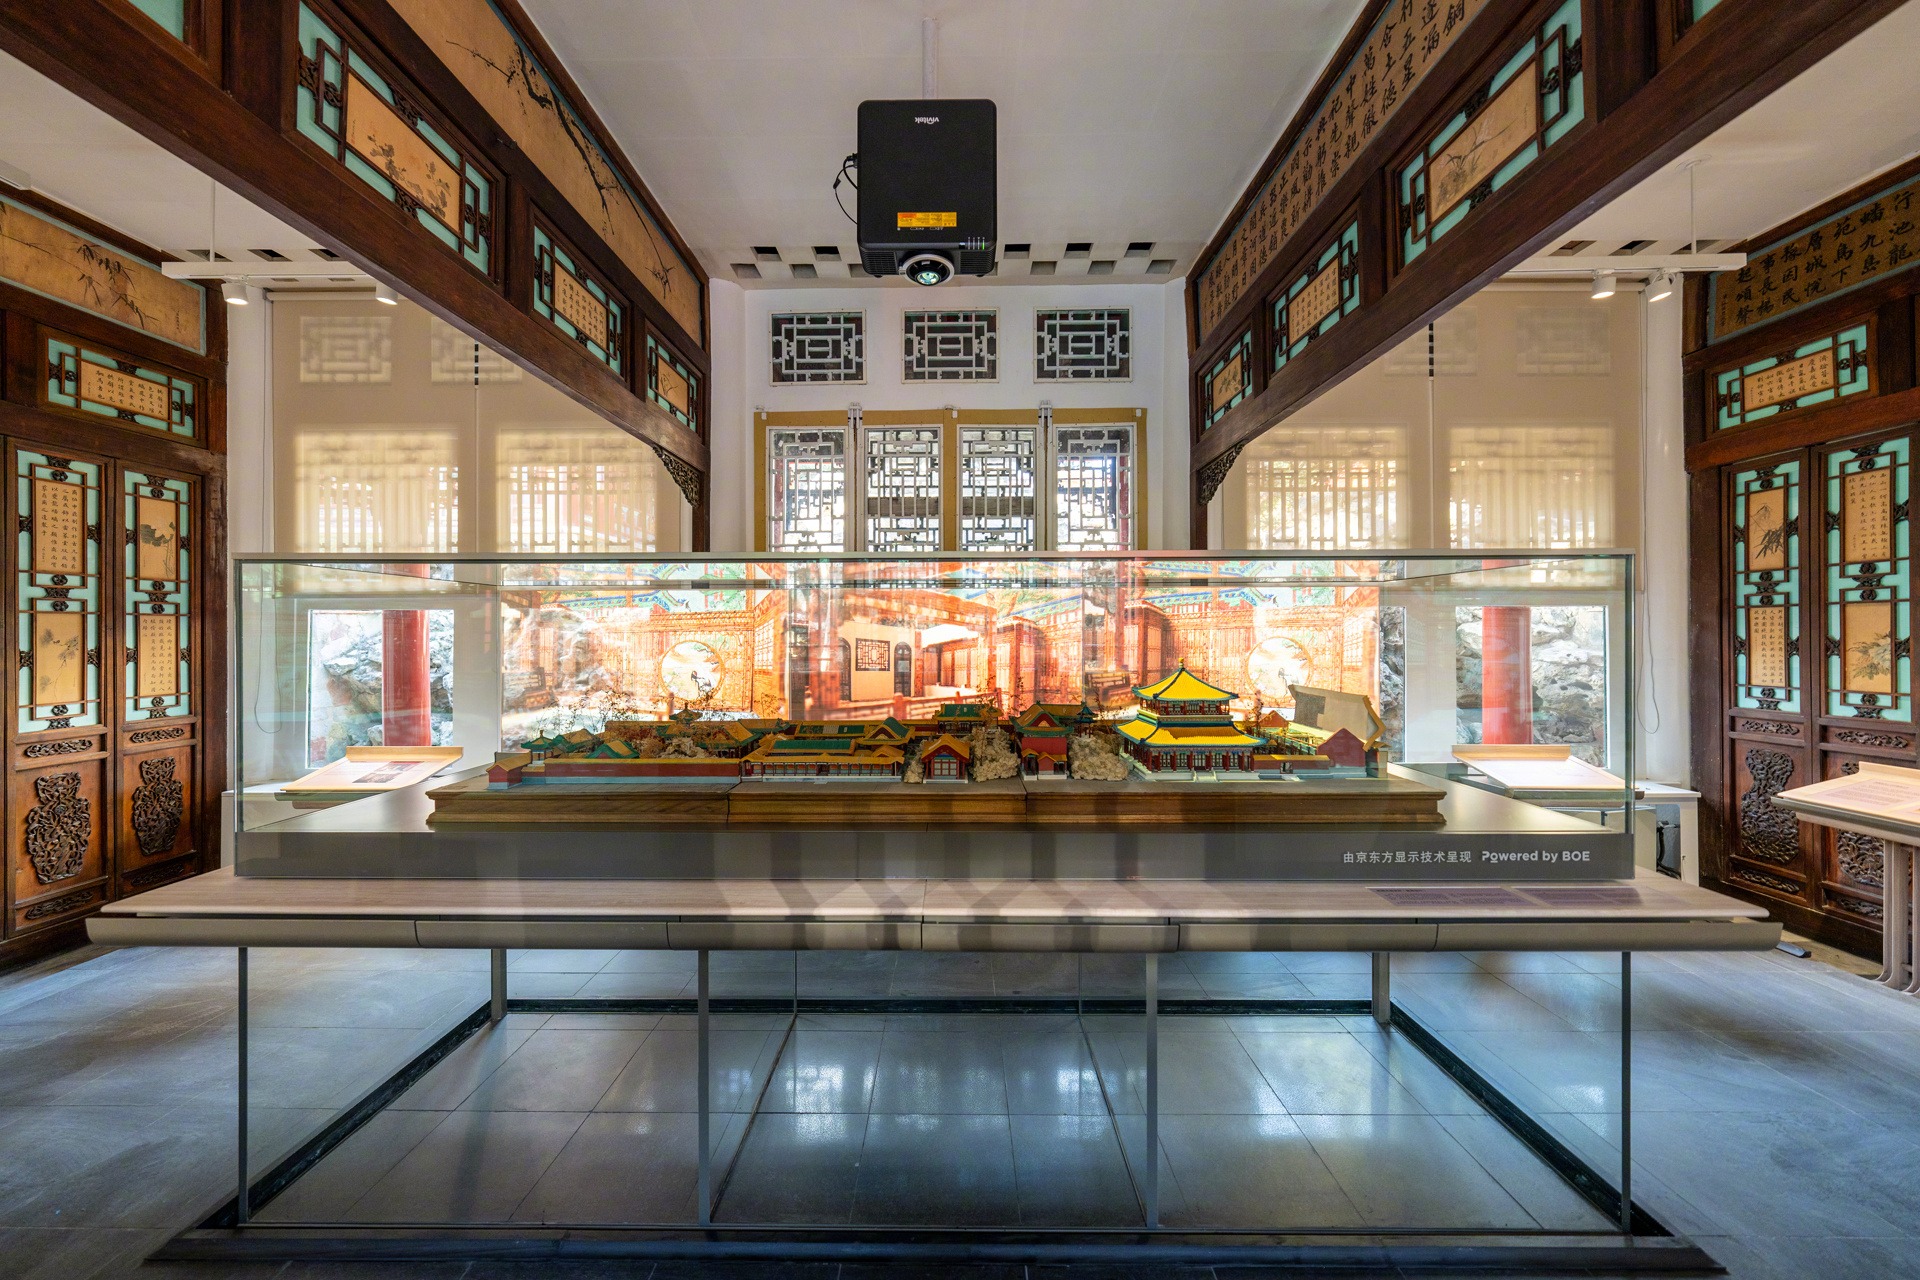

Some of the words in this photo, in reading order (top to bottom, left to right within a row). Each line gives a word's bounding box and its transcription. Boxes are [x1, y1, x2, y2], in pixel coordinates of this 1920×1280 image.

[1343, 851, 1471, 864] 由京东方显示技术呈现
[1482, 850, 1538, 863] Powered
[1542, 850, 1558, 863] by
[1562, 851, 1590, 861] BOE
